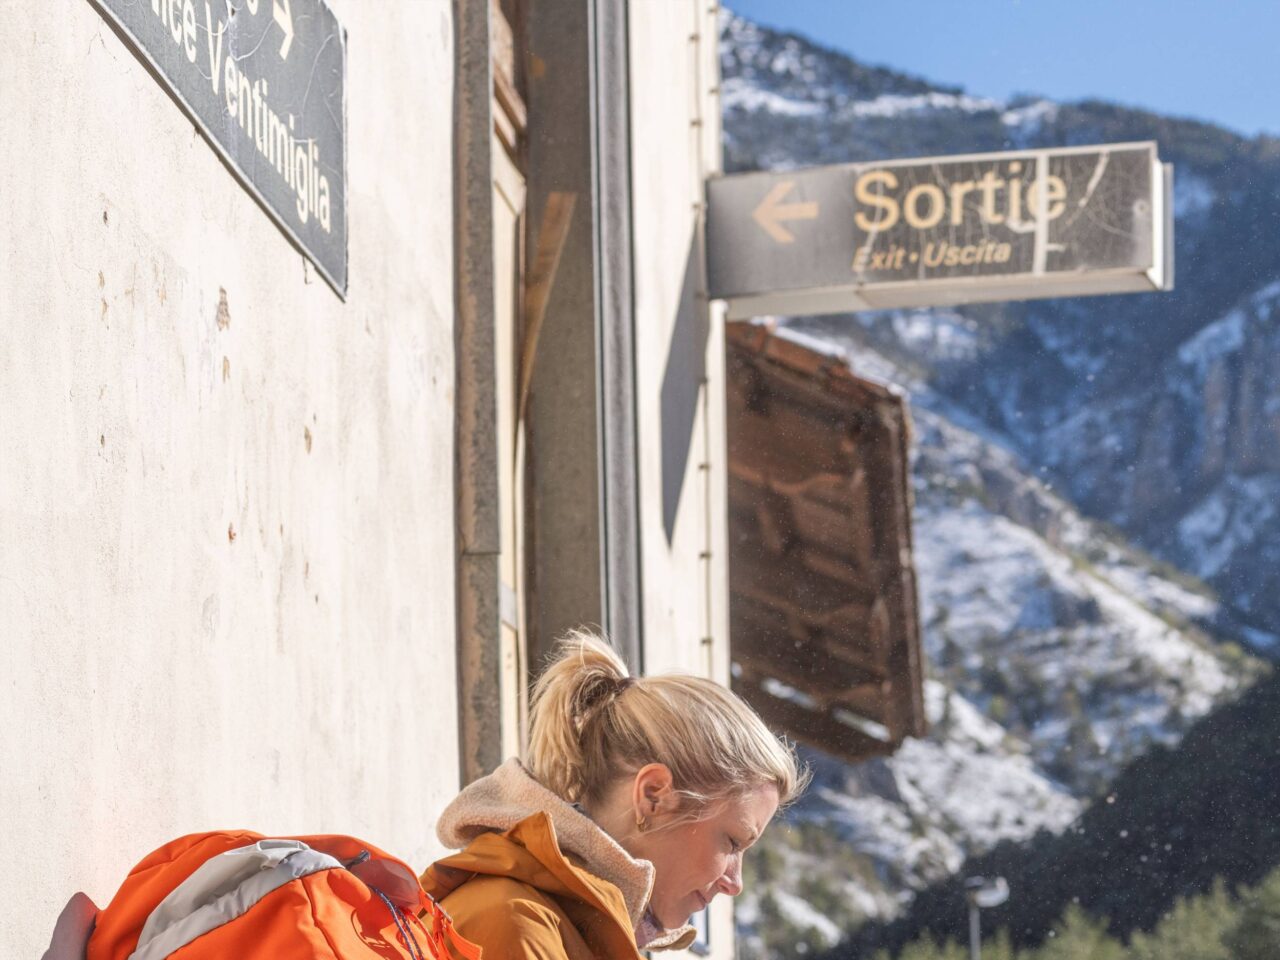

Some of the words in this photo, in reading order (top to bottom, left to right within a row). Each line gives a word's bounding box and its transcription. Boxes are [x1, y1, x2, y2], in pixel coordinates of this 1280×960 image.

[205, 1, 331, 233] Ventimiglia
[854, 161, 1067, 232] Sortie
[853, 243, 905, 272] Exit
[923, 239, 1012, 267] Uscita
